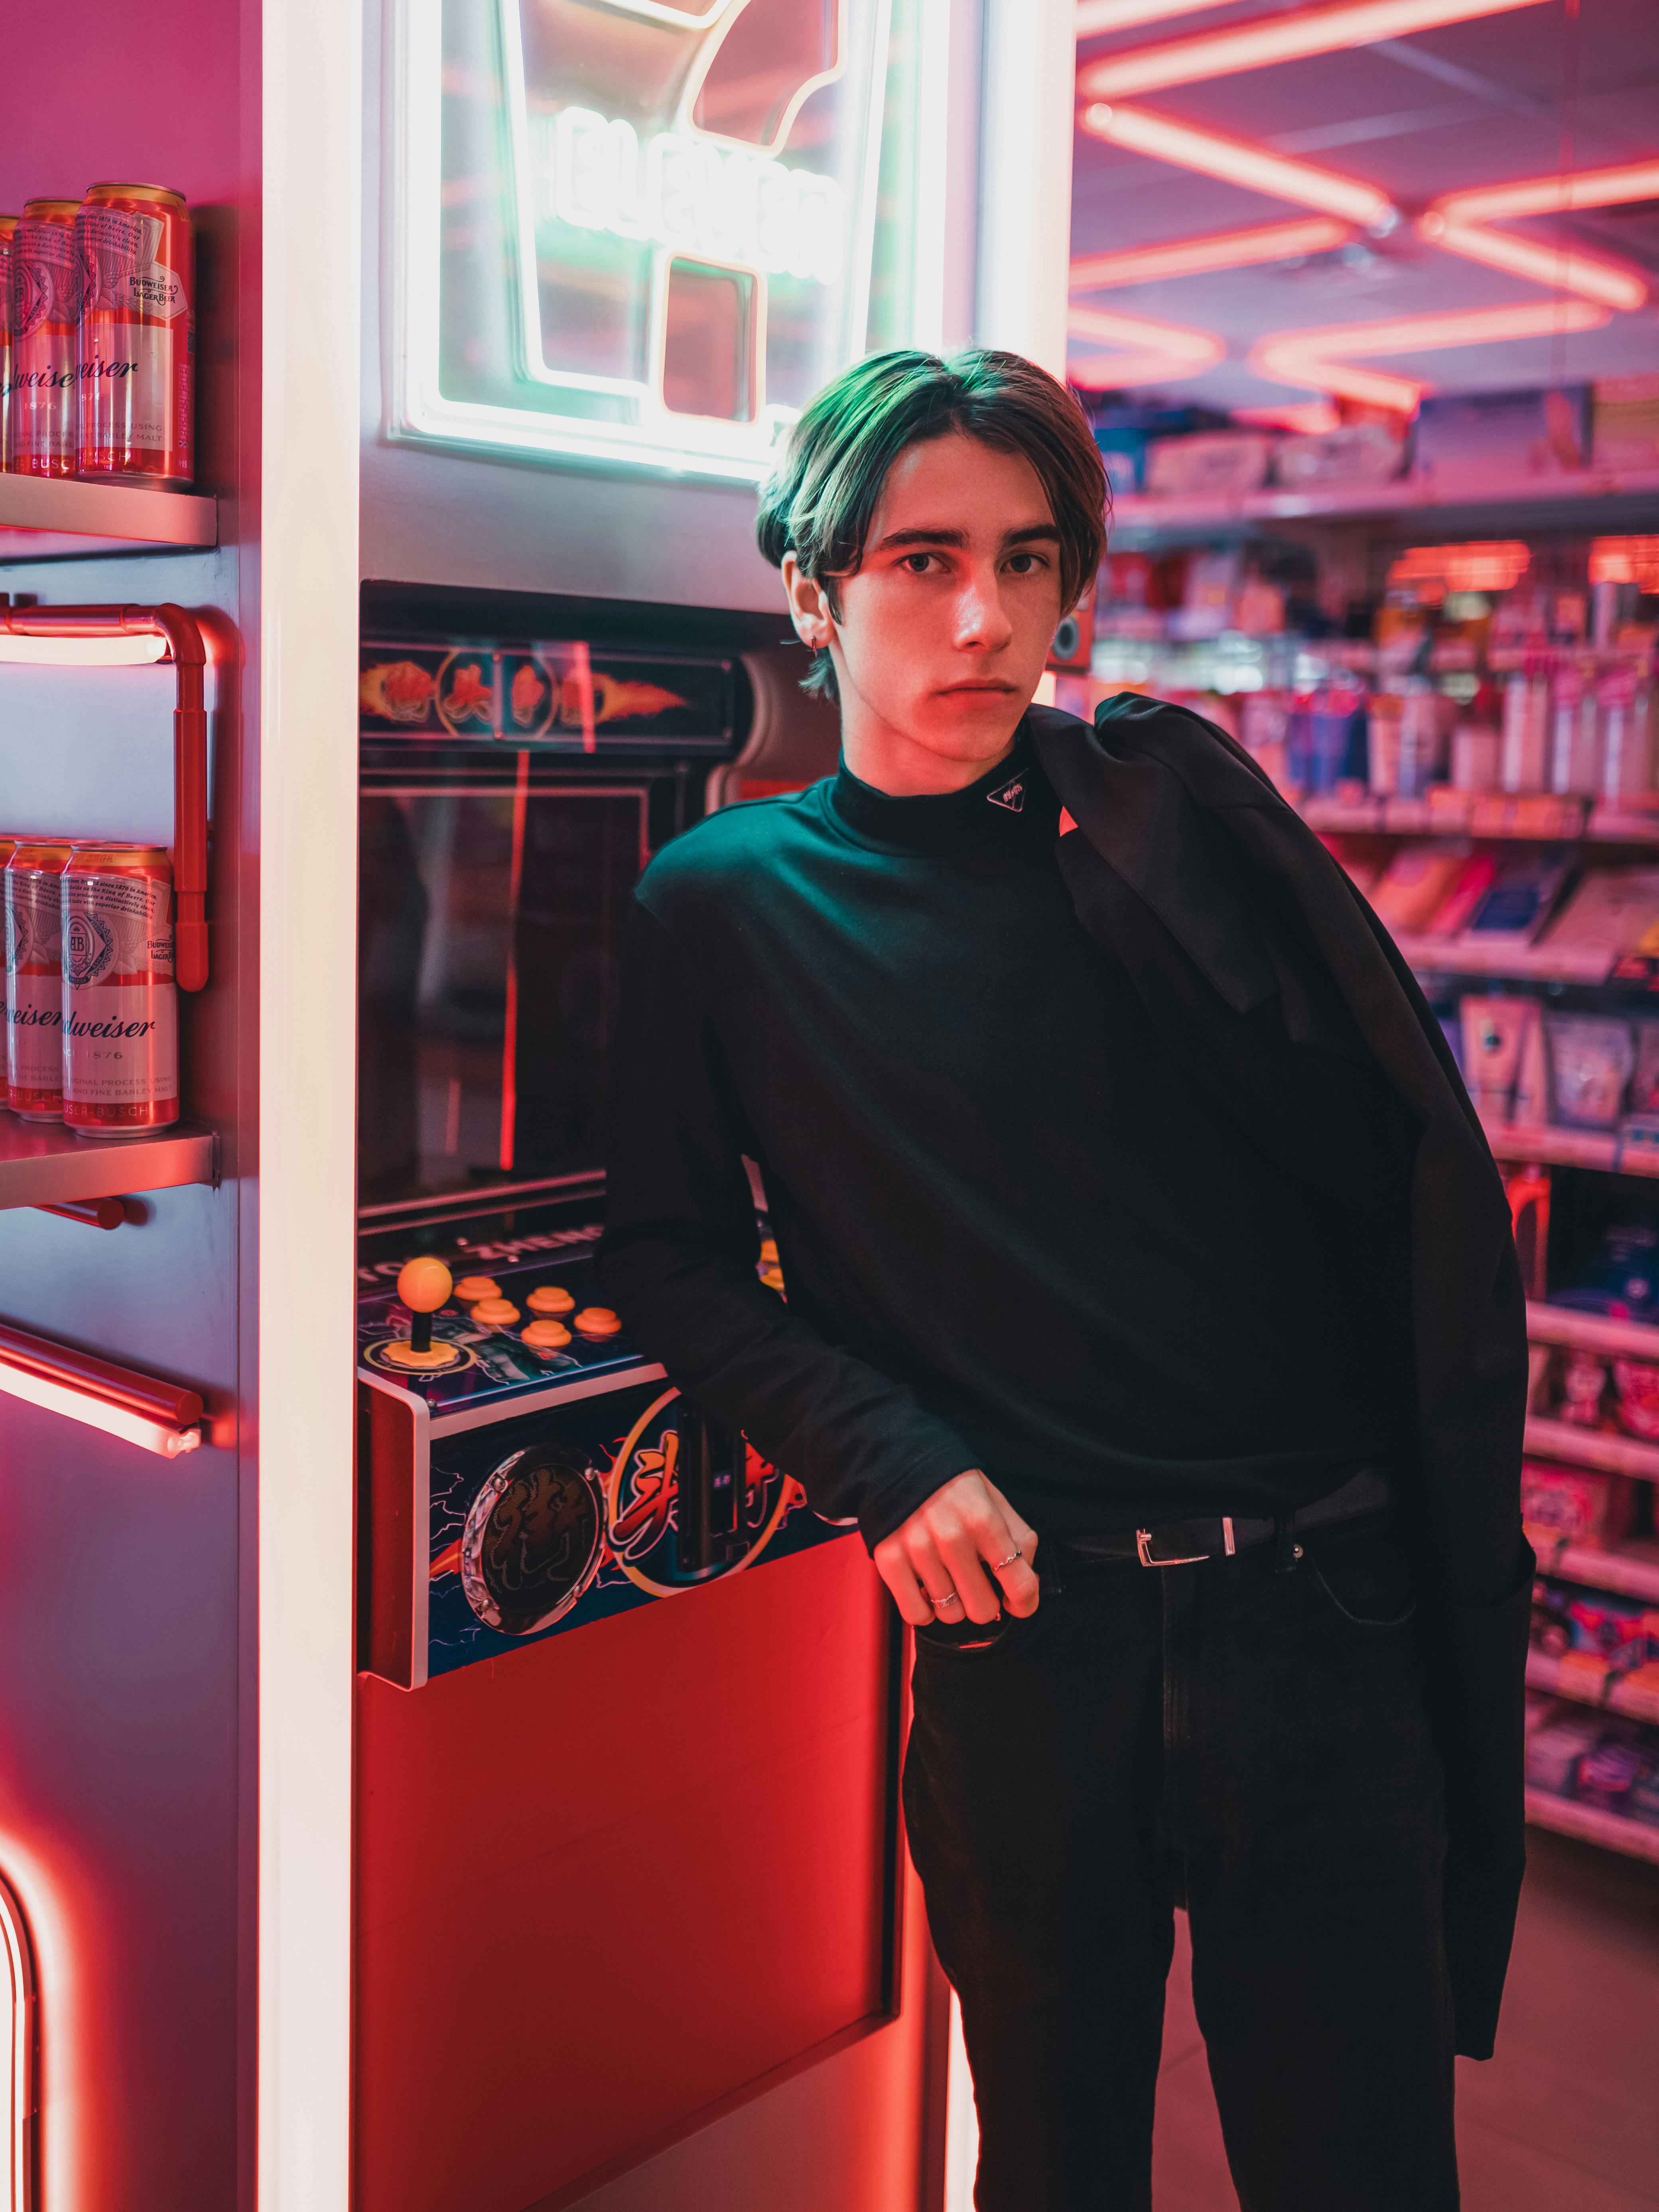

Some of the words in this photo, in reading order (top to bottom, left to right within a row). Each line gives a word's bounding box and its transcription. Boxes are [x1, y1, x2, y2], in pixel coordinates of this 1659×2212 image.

[130, 276, 173, 292] BUDWEISER
[134, 288, 160, 302] LAGER
[159, 293, 175, 303] BEER
[75, 355, 138, 380] weiser
[147, 941, 172, 949] BUDWEIS
[63, 1011, 155, 1038] dweiser
